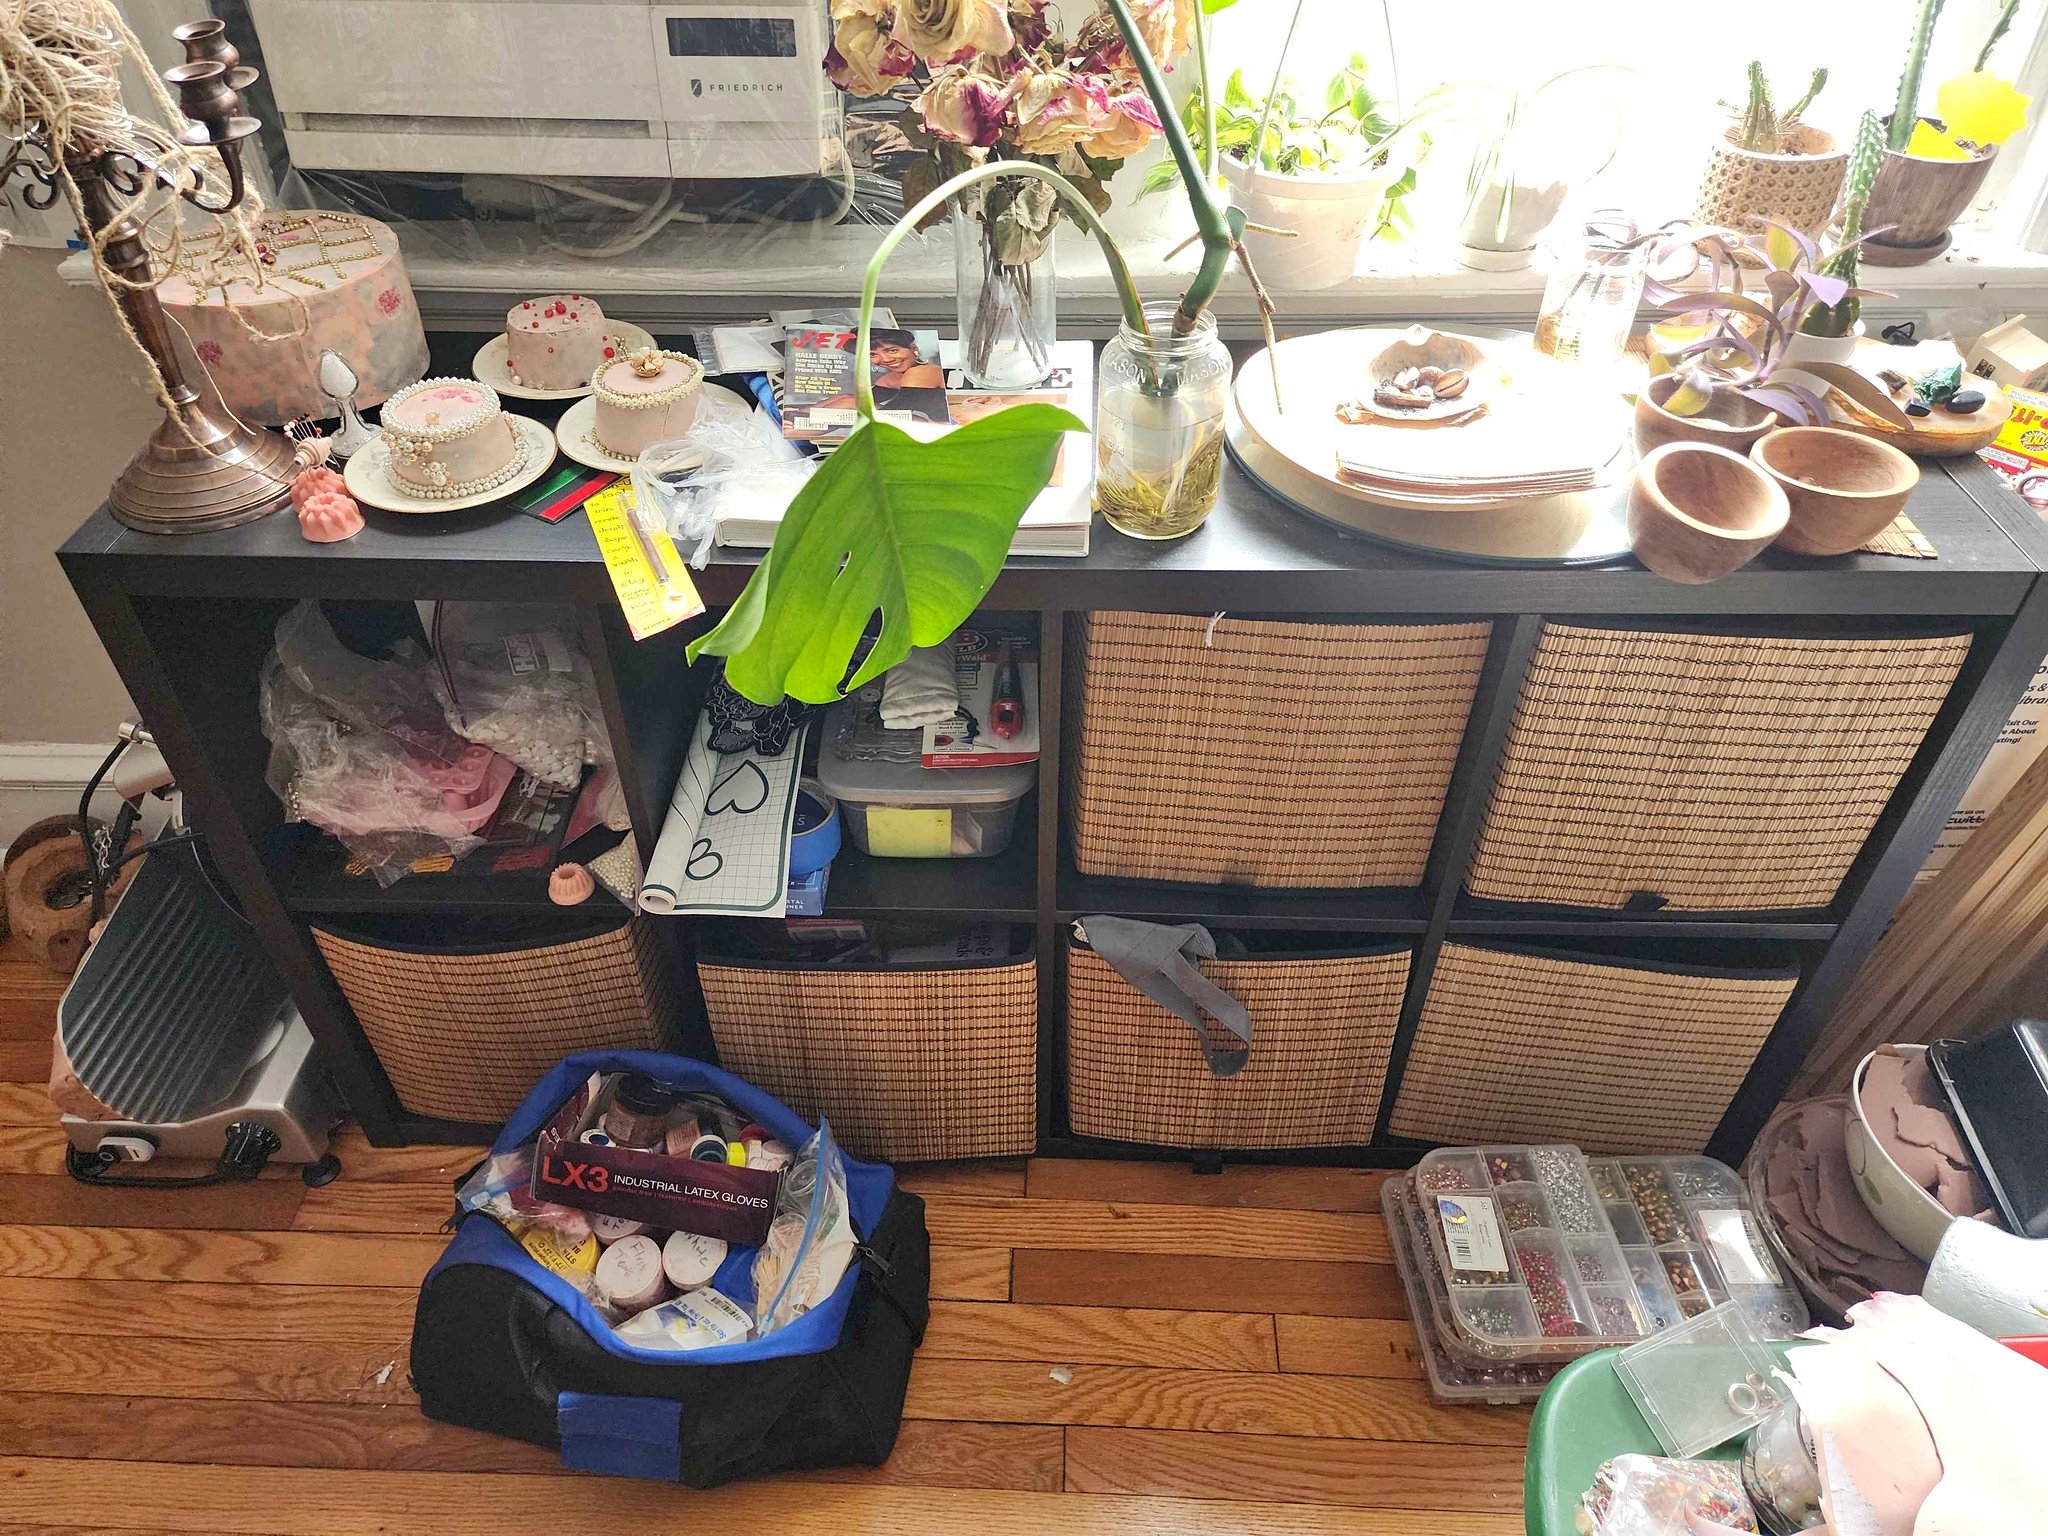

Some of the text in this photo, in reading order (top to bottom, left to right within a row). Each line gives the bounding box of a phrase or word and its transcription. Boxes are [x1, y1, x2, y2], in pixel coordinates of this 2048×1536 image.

[709, 84, 783, 92] FRIEDRICH
[791, 330, 857, 350] JET
[542, 1156, 769, 1209] LX3 INDUSTRIAL LATEX GLOVES
